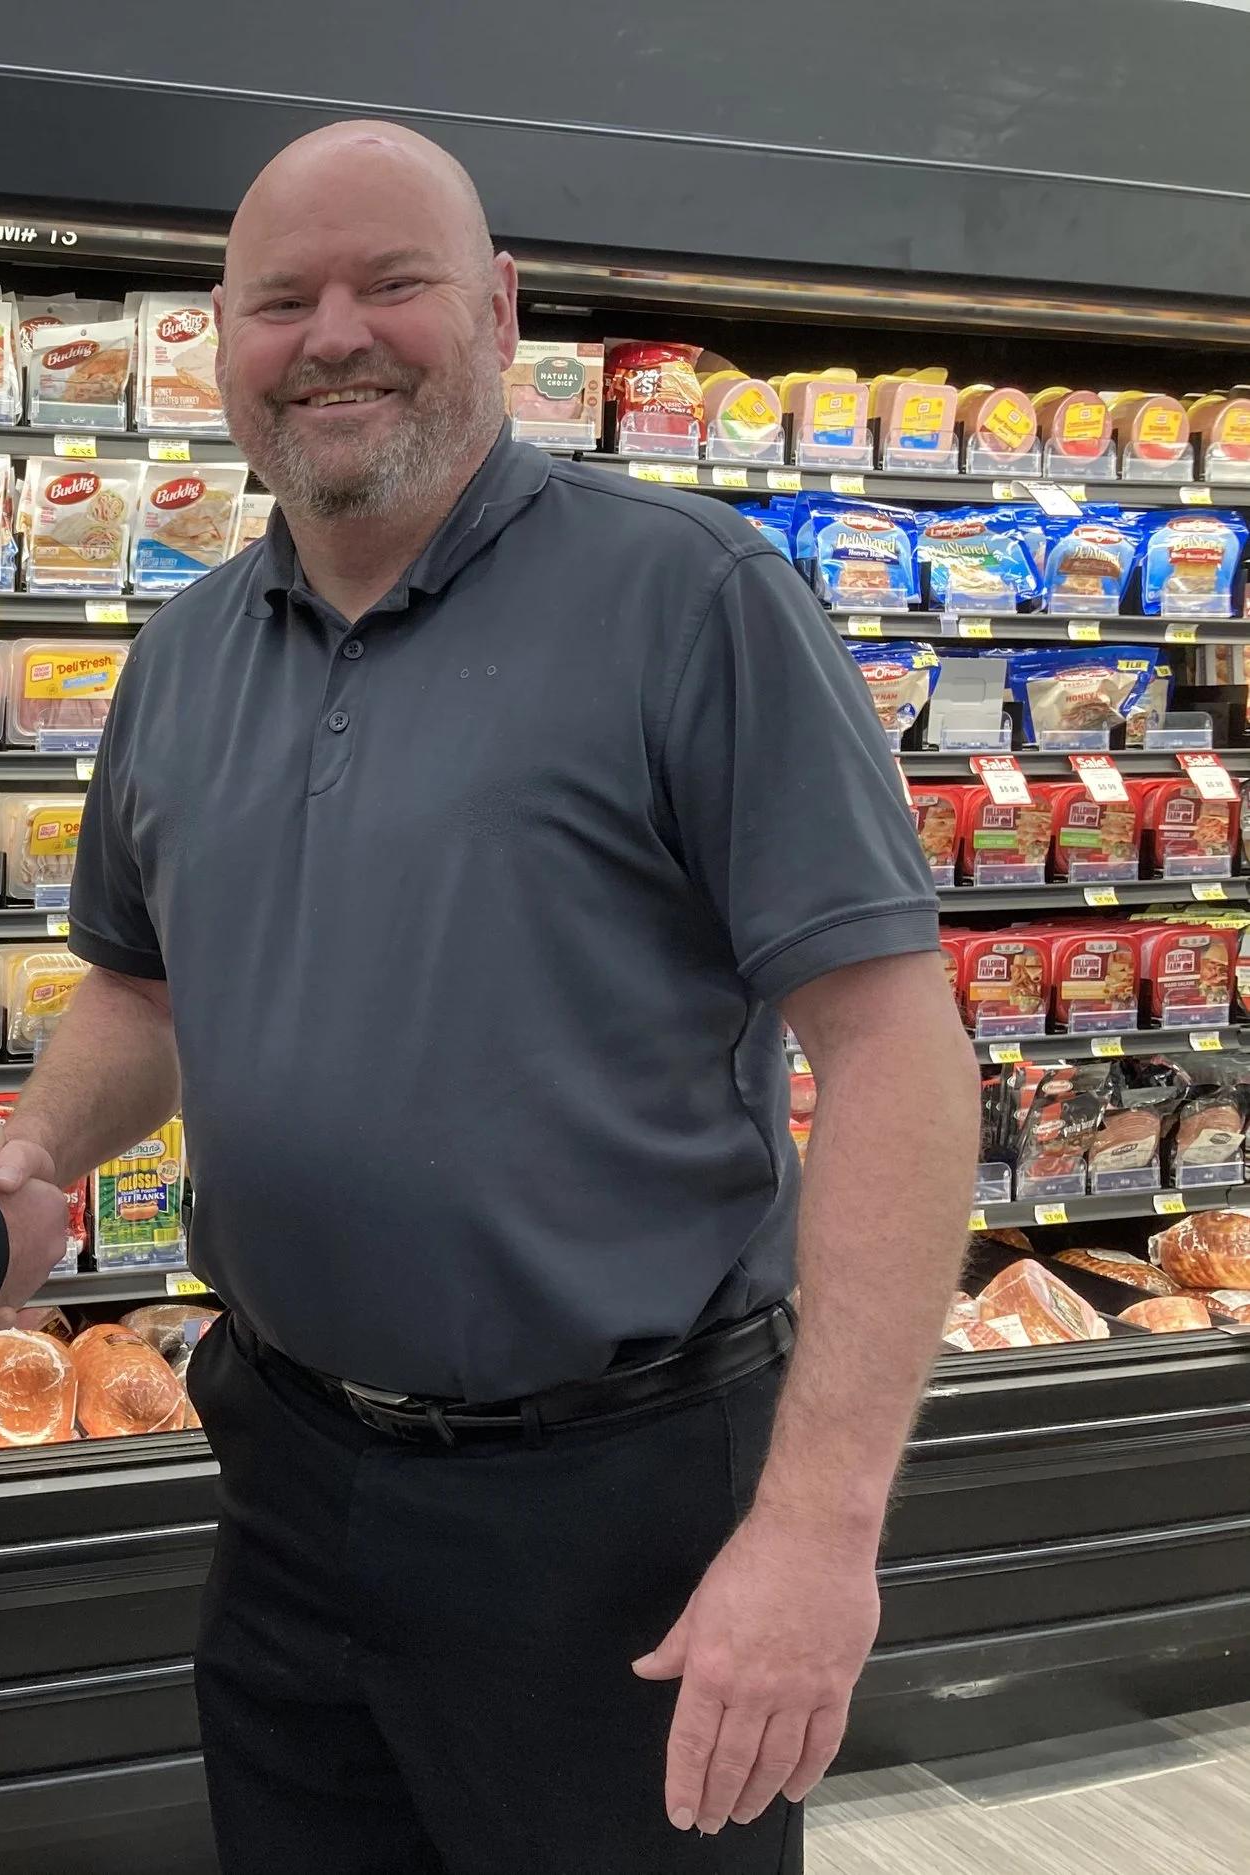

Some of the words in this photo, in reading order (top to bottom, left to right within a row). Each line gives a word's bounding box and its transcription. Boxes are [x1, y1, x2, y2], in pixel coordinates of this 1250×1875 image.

[47, 343, 98, 367] Buddig
[540, 372, 578, 381] NATURAL
[547, 379, 573, 387] CHOICE
[50, 477, 96, 500] Buddig
[155, 482, 200, 504] Buddig
[33, 664, 51, 673] Oscar
[57, 661, 80, 674] Deli
[81, 655, 112, 670] Fresh
[33, 670, 51, 679] Mayer
[979, 758, 1014, 771] Sale!
[1076, 756, 1111, 769] Sale!
[1183, 754, 1217, 767] Sale!
[985, 816, 999, 825] FARM
[1071, 814, 1085, 822] FARM
[161, 1167, 176, 1175] BEEF
[133, 1192, 165, 1201] FRANKS
